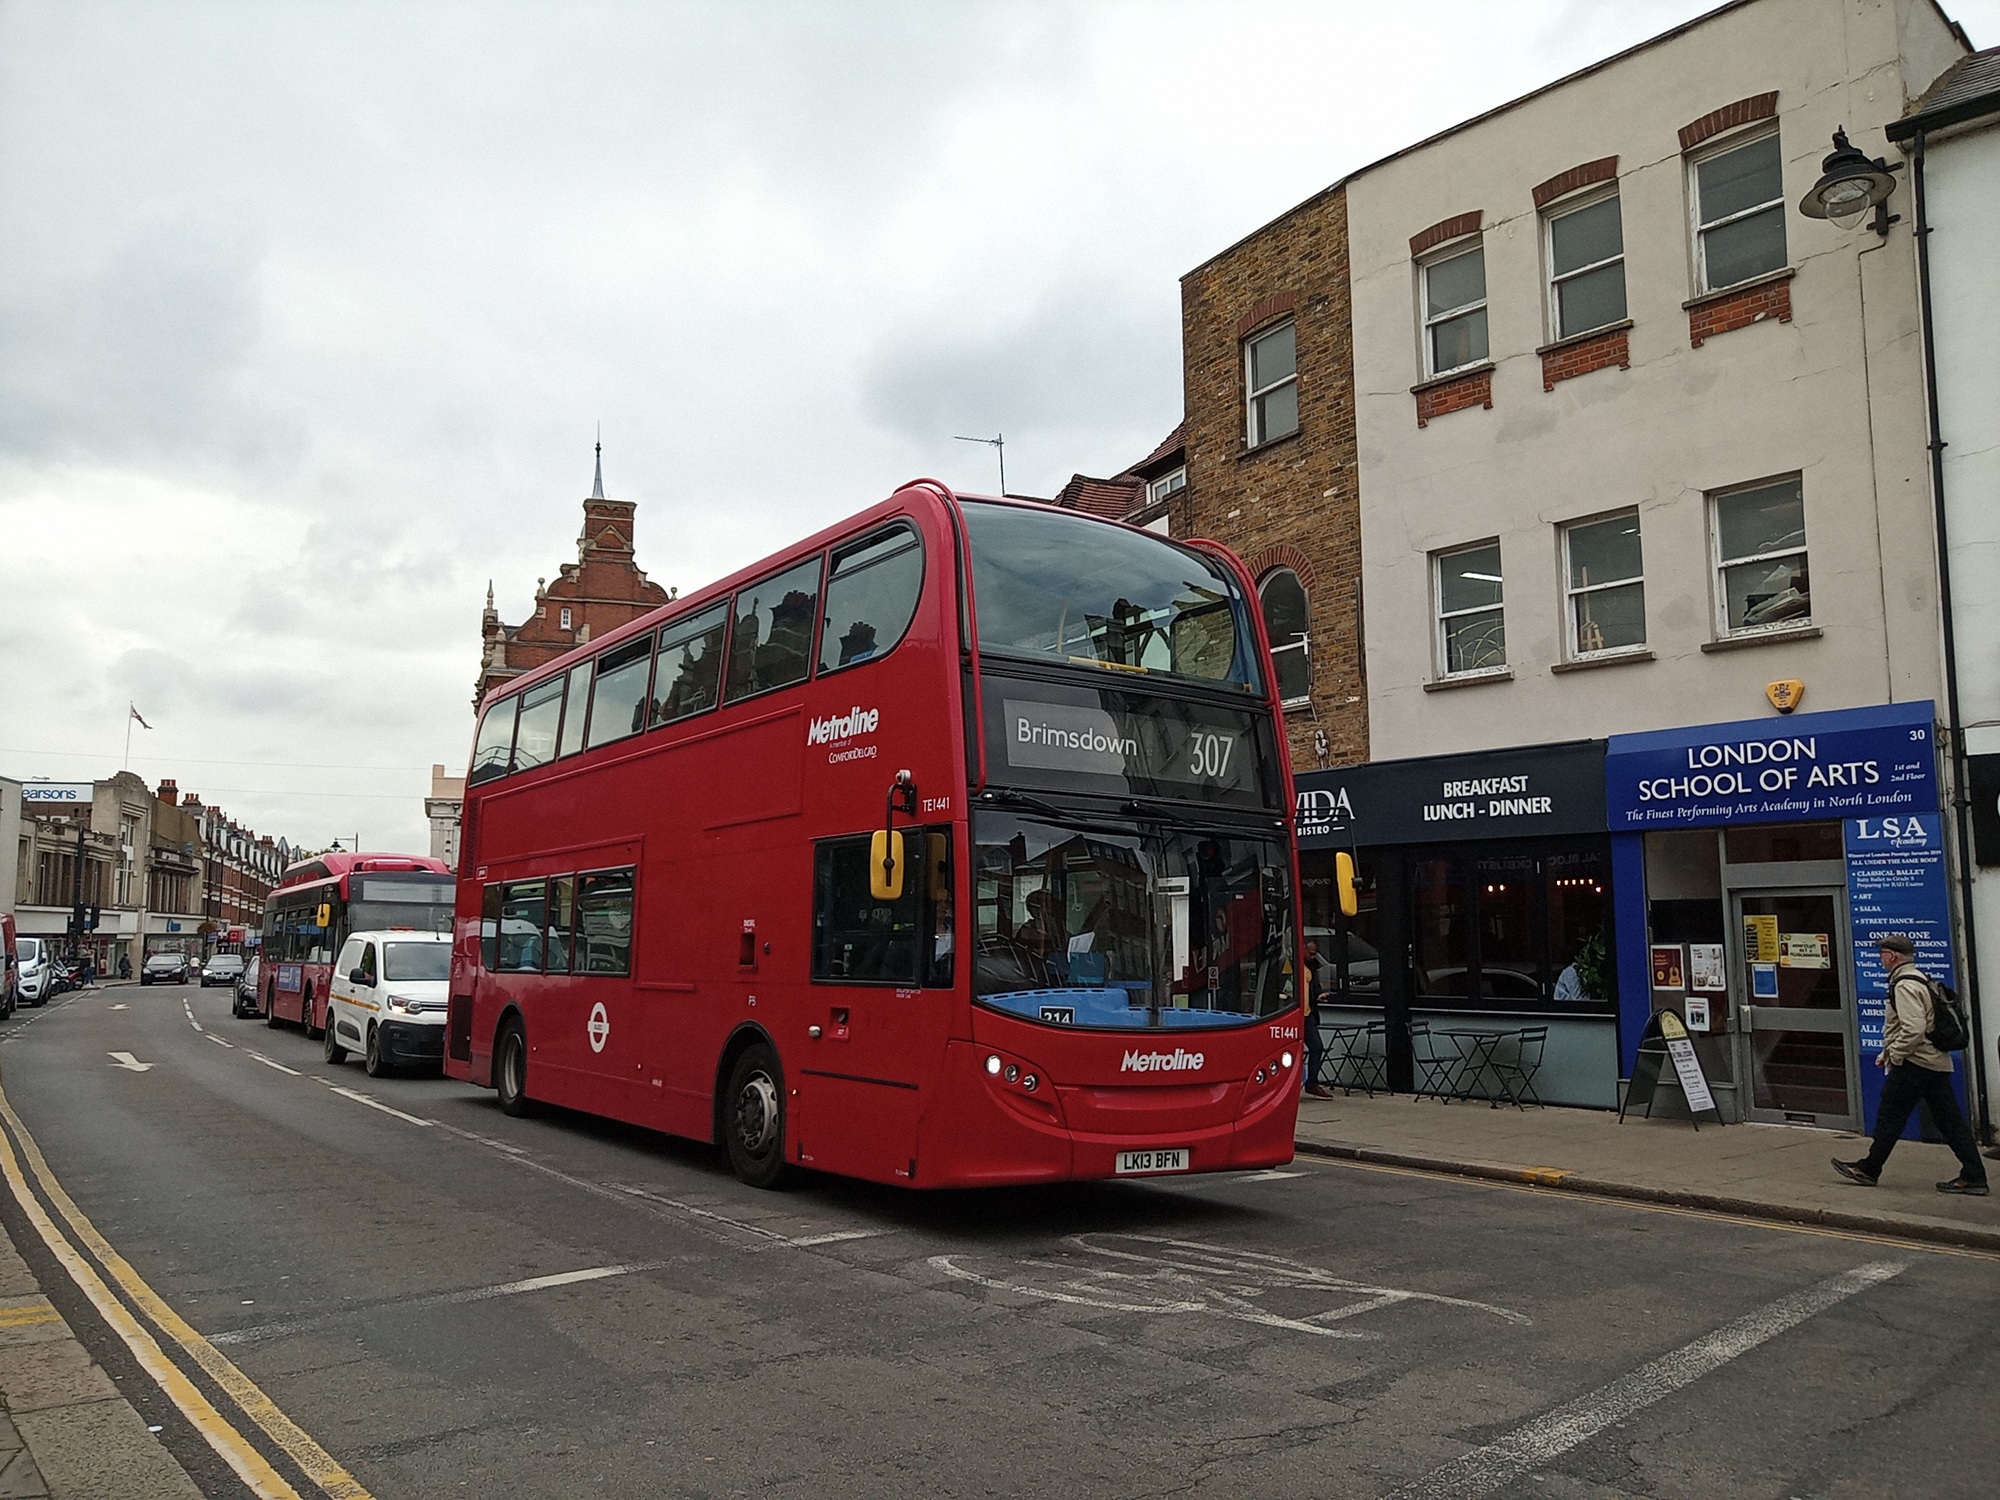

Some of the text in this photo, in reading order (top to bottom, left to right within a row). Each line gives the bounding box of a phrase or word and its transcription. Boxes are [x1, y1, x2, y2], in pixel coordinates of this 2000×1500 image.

[807, 706, 879, 746] Metroline
[1017, 717, 1138, 756] Brimsdown
[1910, 730, 1925, 741] 30
[1190, 732, 1233, 777] 307
[1688, 737, 1816, 770] LONDON
[1443, 775, 1528, 798] BREAKFAST
[1638, 760, 1880, 801] SCHOOL OF ARTS
[1890, 772, 1926, 782] 2nd Floor
[22, 789, 76, 799] earsons
[923, 796, 950, 812] TE1441
[1423, 802, 1475, 821] LUNCH
[1489, 797, 1552, 817] DINNER
[1625, 790, 1912, 821] The Finest Performing Arts Academy in North London
[1297, 826, 1330, 836] BISTRO
[1856, 817, 1927, 839] LSA
[1890, 837, 1927, 848] Academy
[1915, 961, 1950, 970] axophone
[1269, 1026, 1298, 1039] TE1441
[1860, 1025, 1879, 1033] ALL
[1120, 1048, 1204, 1072] Metroline
[1124, 1151, 1180, 1171] LK13 BFN
